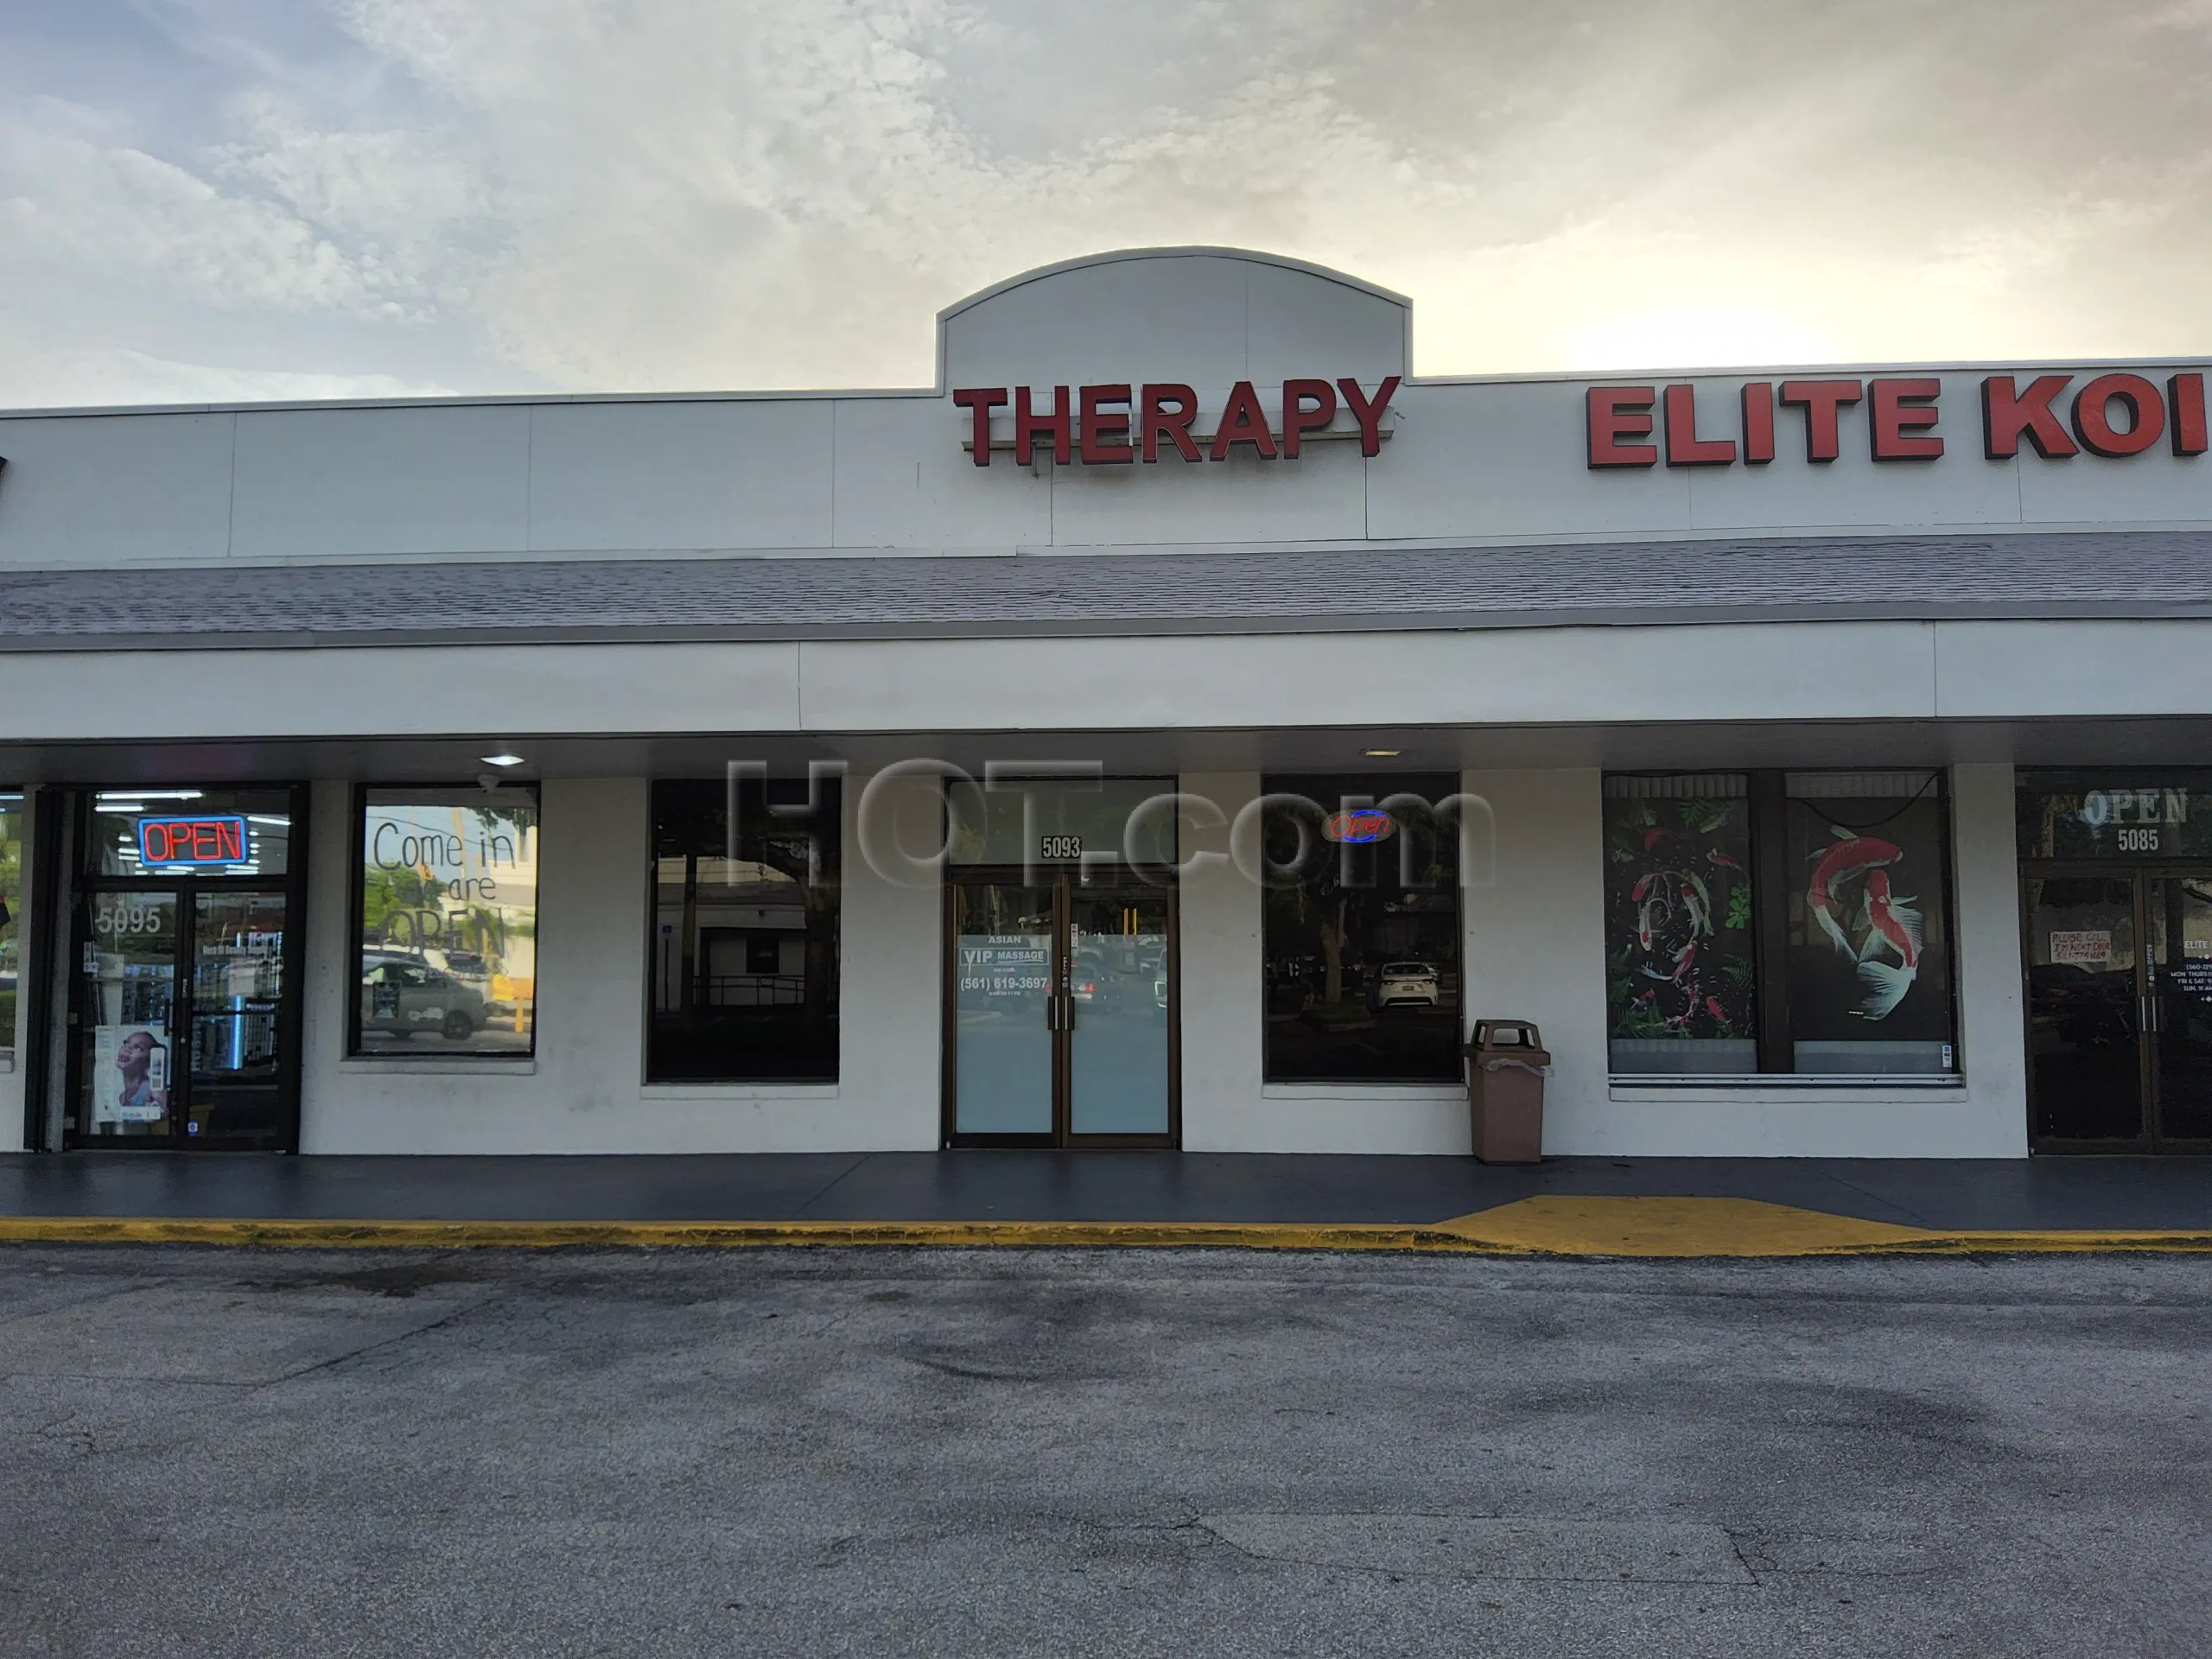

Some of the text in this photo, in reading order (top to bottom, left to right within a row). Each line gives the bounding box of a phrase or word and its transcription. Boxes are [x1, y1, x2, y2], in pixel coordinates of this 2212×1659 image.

[953, 376, 1402, 467] THERAPY
[1586, 372, 2209, 469] ELITE KOI
[2084, 787, 2188, 824] OPEN
[144, 821, 241, 861] OPEN
[373, 822, 516, 871] Come in
[1042, 836, 1081, 858] 5093
[2118, 829, 2159, 851] 5085
[448, 876, 497, 901] are
[94, 906, 161, 933] 5095
[379, 907, 505, 961] OPEN
[988, 936, 1021, 944] ASIAN
[2184, 940, 2209, 949] ELITE
[963, 950, 1045, 963] VIP MASSAGE
[960, 977, 1047, 992] (561) 619-3697
